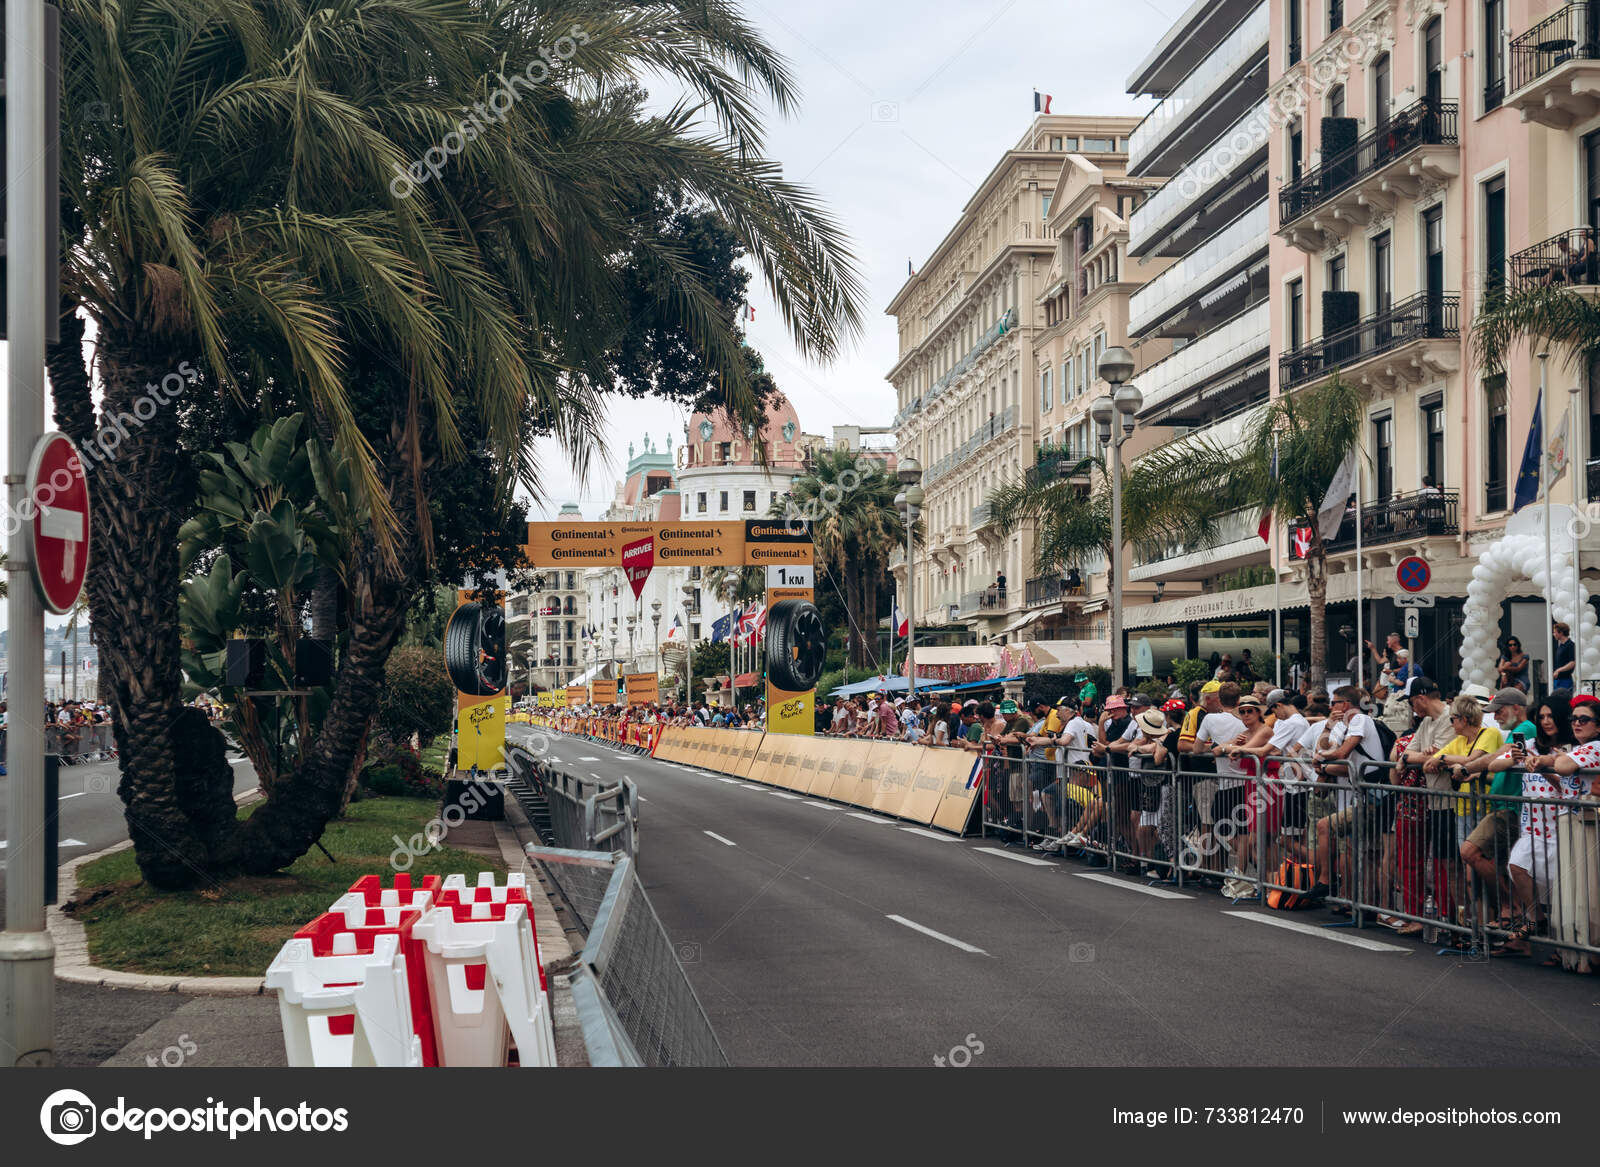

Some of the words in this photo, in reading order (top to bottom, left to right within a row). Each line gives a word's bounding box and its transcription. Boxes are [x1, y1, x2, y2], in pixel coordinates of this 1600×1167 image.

[551, 529, 607, 541] Continental
[659, 528, 714, 541] Continental
[751, 525, 800, 537] Continental
[551, 547, 607, 560] Continental
[659, 546, 714, 559] Continental
[751, 548, 800, 560] Continental
[627, 566, 634, 582] 1
[635, 568, 649, 580] KM
[778, 568, 786, 585] 1
[789, 576, 805, 585] KM
[1184, 601, 1224, 616] RESTAURANT
[1226, 600, 1234, 610] LE
